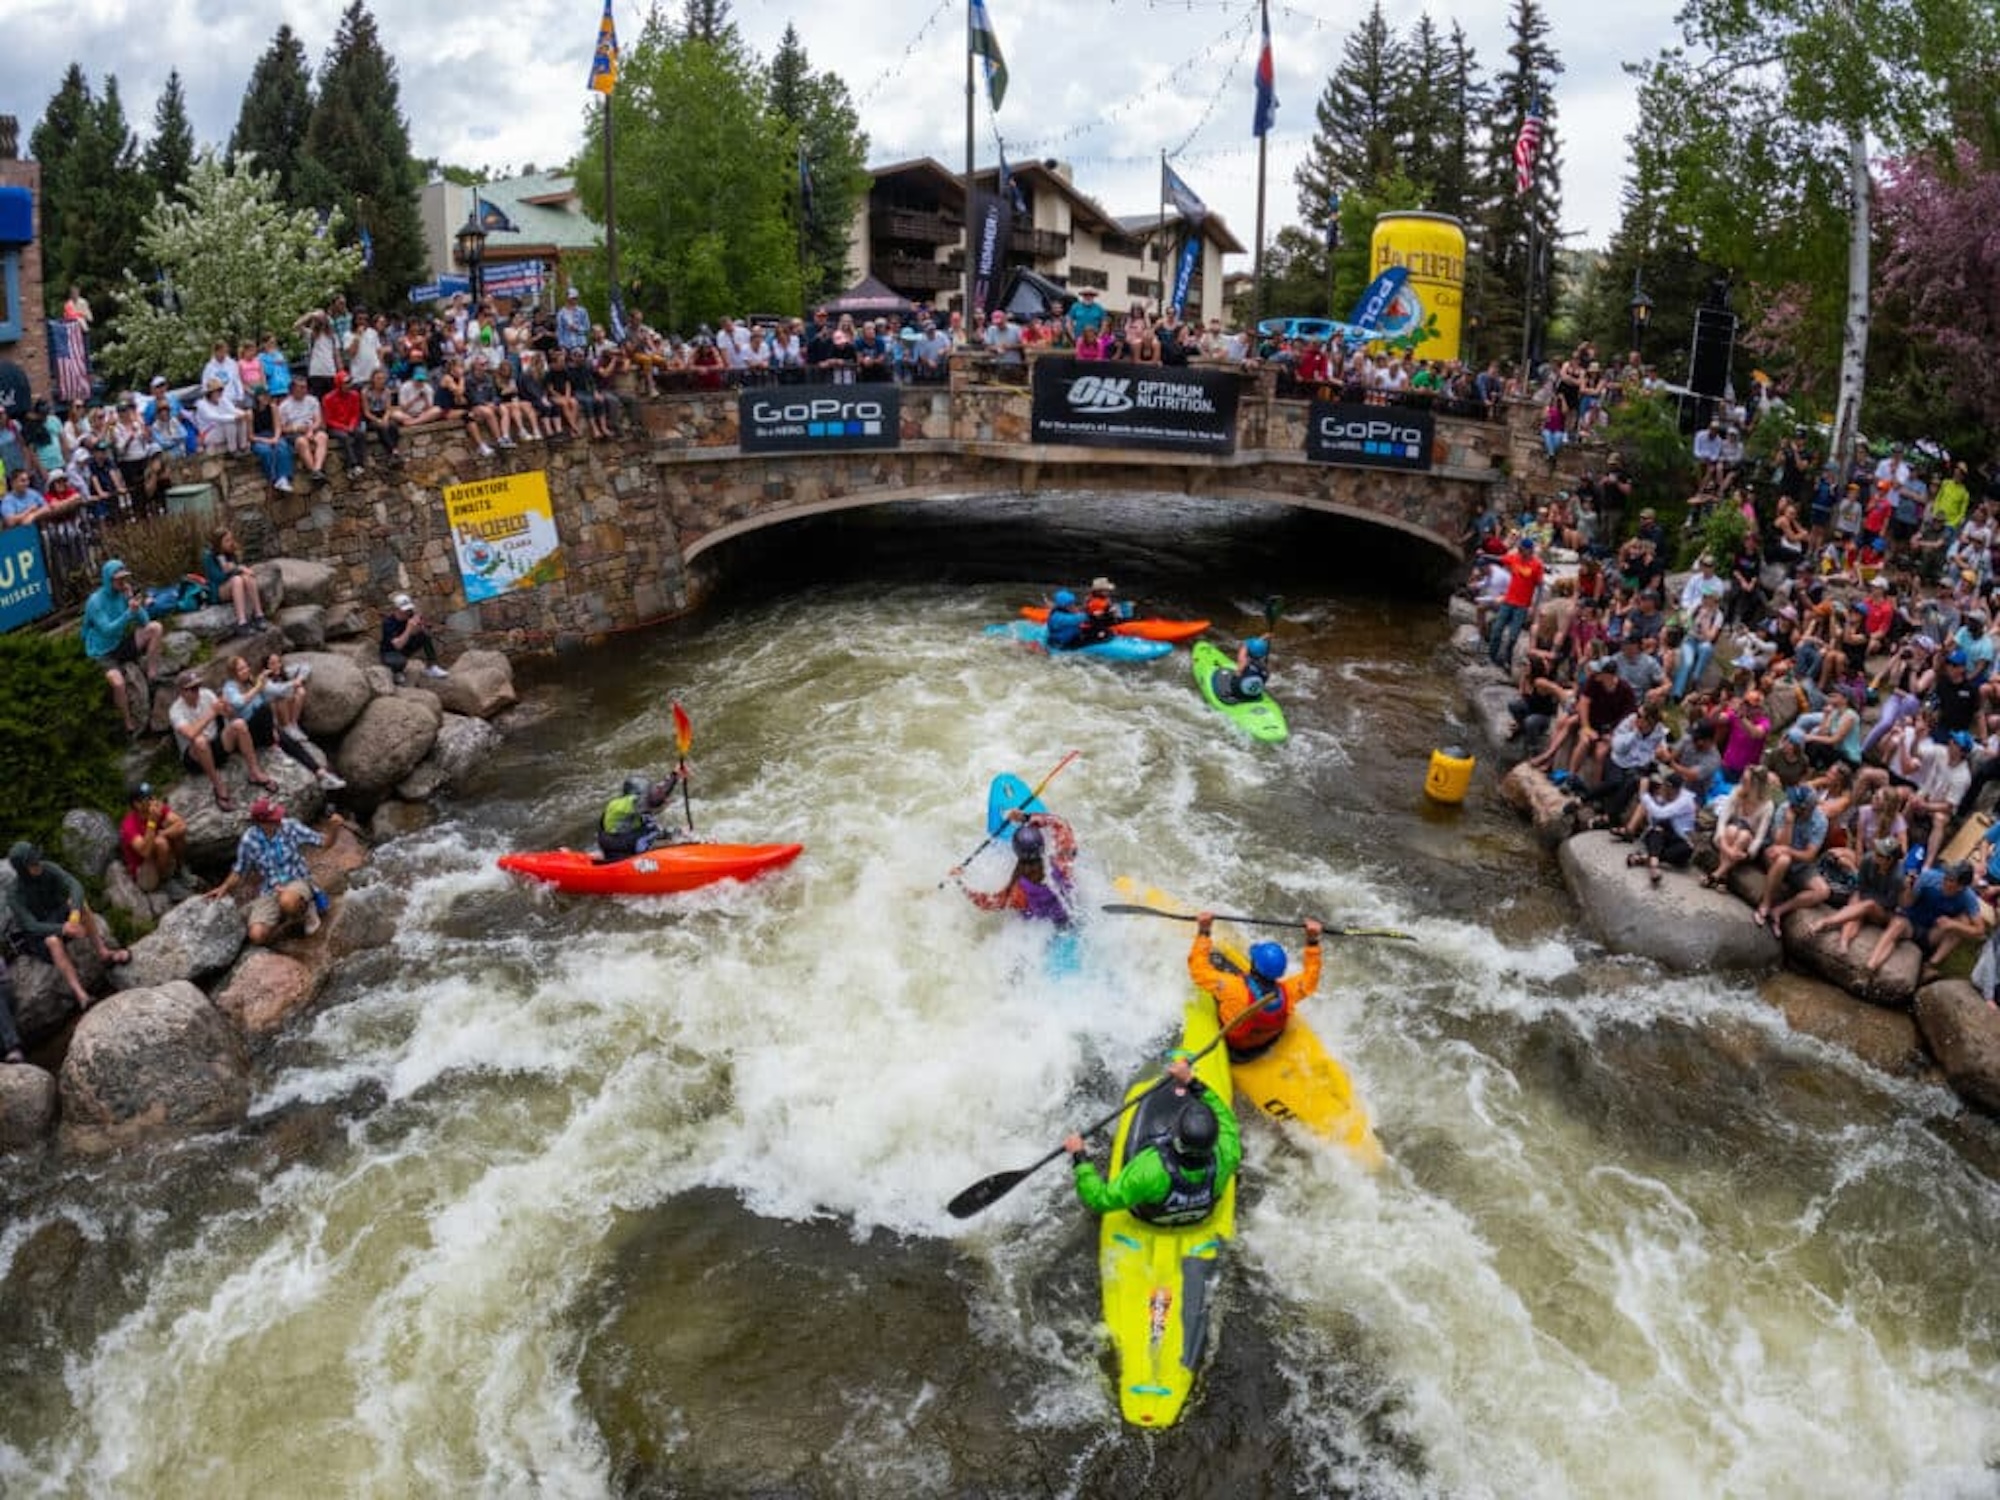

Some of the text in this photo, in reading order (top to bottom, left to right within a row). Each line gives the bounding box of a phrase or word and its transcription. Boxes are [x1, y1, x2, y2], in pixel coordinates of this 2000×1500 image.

[1067, 375, 1204, 406] ON OPTIMUM
[753, 399, 883, 423] GoPro
[1321, 416, 1421, 443] GoPro
[450, 480, 509, 501] ADVENTURE
